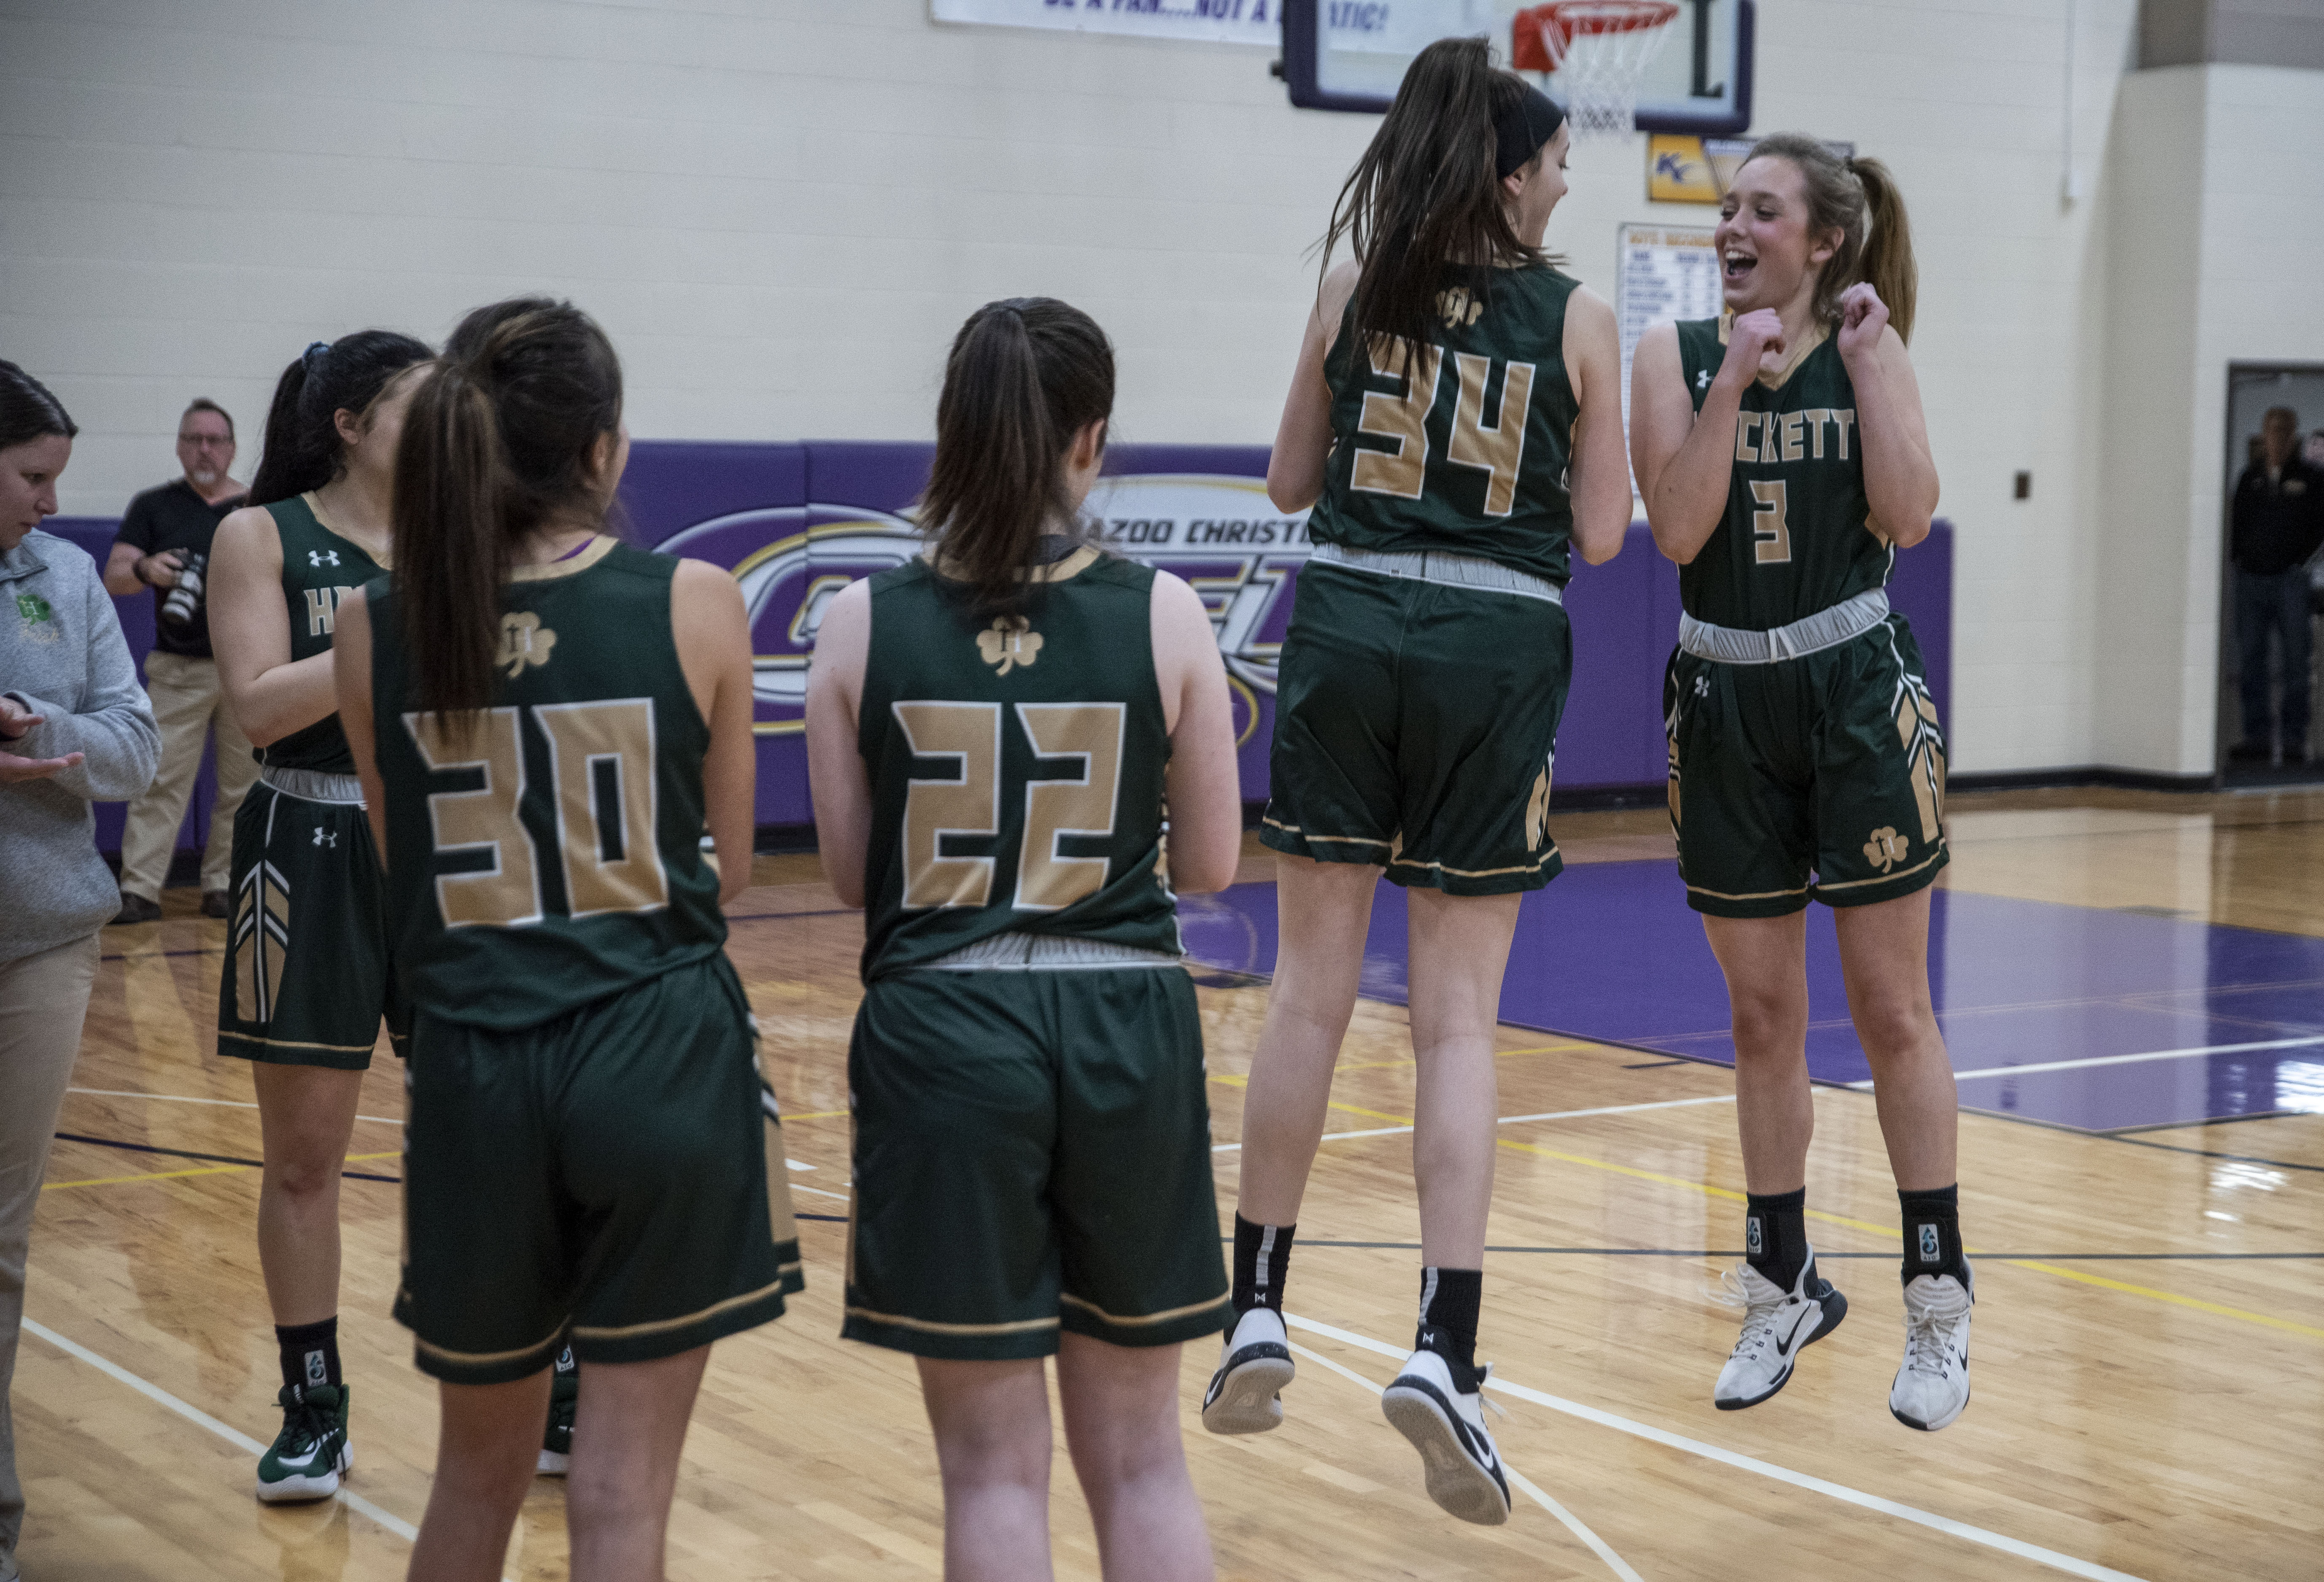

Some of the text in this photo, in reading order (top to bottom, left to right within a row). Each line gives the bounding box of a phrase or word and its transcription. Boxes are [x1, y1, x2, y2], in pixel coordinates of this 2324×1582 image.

[1351, 329, 1536, 517] 34
[1749, 479, 1792, 565] 3
[402, 698, 669, 929] 30
[891, 700, 1127, 911] 22
